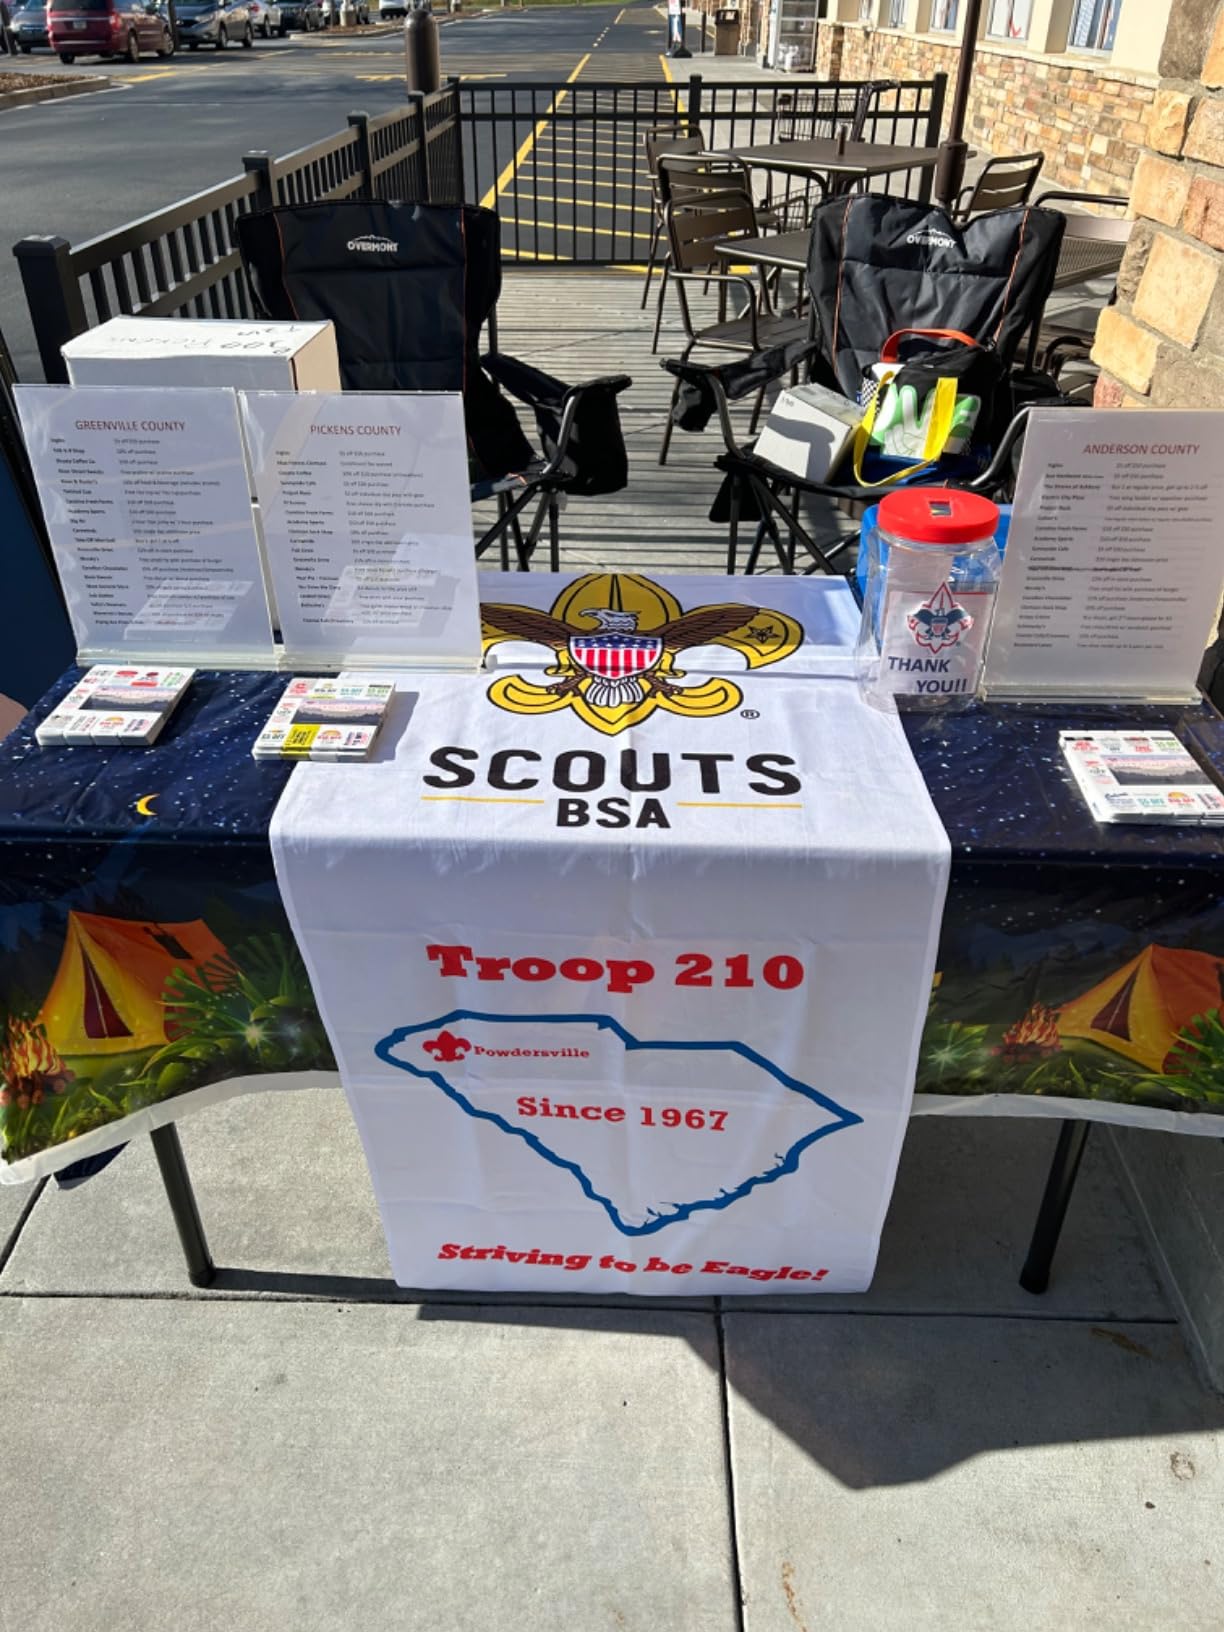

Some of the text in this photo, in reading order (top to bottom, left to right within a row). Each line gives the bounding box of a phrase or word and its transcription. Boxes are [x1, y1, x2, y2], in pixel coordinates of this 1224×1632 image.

[347, 240, 398, 252] OVERMONT
[906, 234, 956, 248] OVERMONT
[75, 420, 186, 432] GREENVILLE COUNTY
[310, 425, 402, 436] PICKENS COUNTY
[1083, 444, 1200, 455] ANDERSON COUNTY
[888, 656, 952, 673] THANK
[916, 679, 968, 694] YOU!!
[422, 746, 802, 796] SCOUTS
[556, 797, 672, 829] BSA
[426, 944, 804, 994] Troop 210
[474, 1046, 590, 1060] Powdersville
[517, 1096, 729, 1131] Since 1967
[438, 1244, 830, 1281] Striving to be Eagle!
